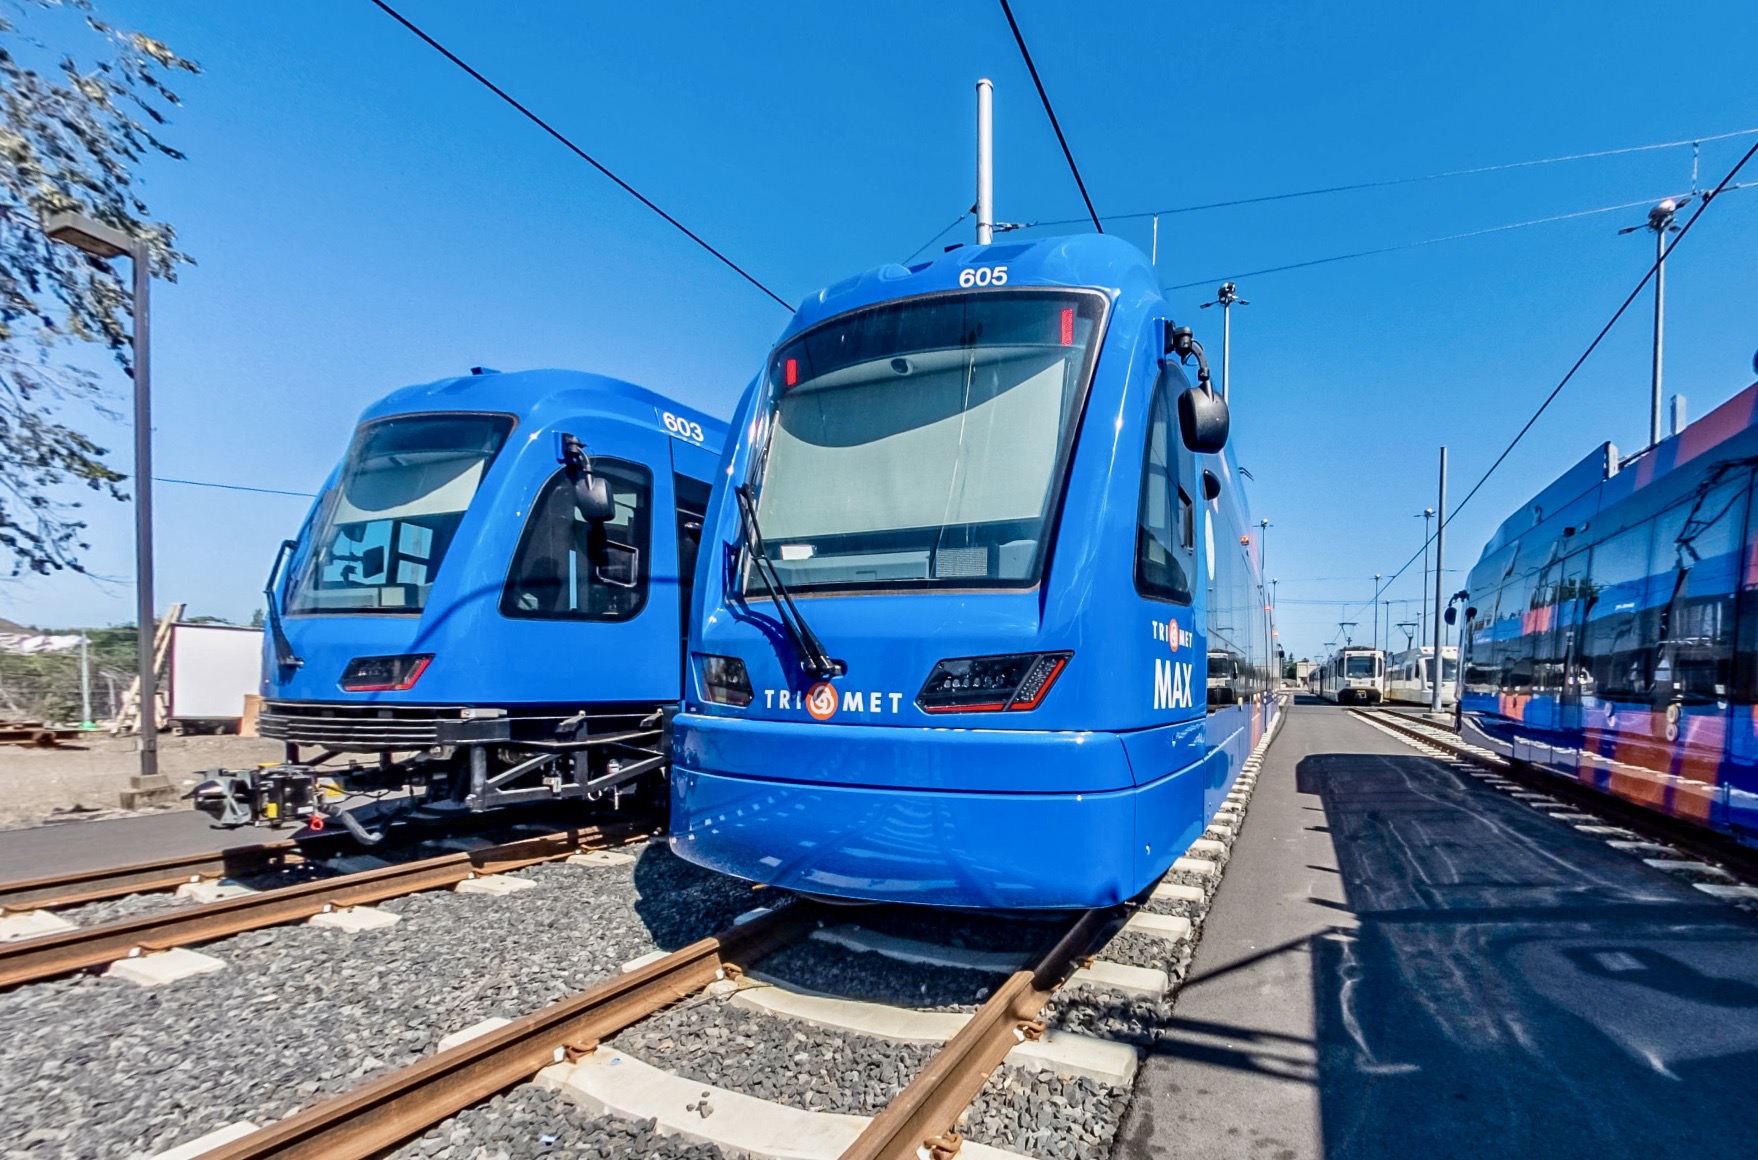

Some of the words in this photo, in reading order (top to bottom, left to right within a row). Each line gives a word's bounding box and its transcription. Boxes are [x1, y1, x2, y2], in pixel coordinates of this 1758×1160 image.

[959, 265, 1008, 288] 605
[662, 411, 704, 442] 603
[1153, 658, 1193, 710] MAX
